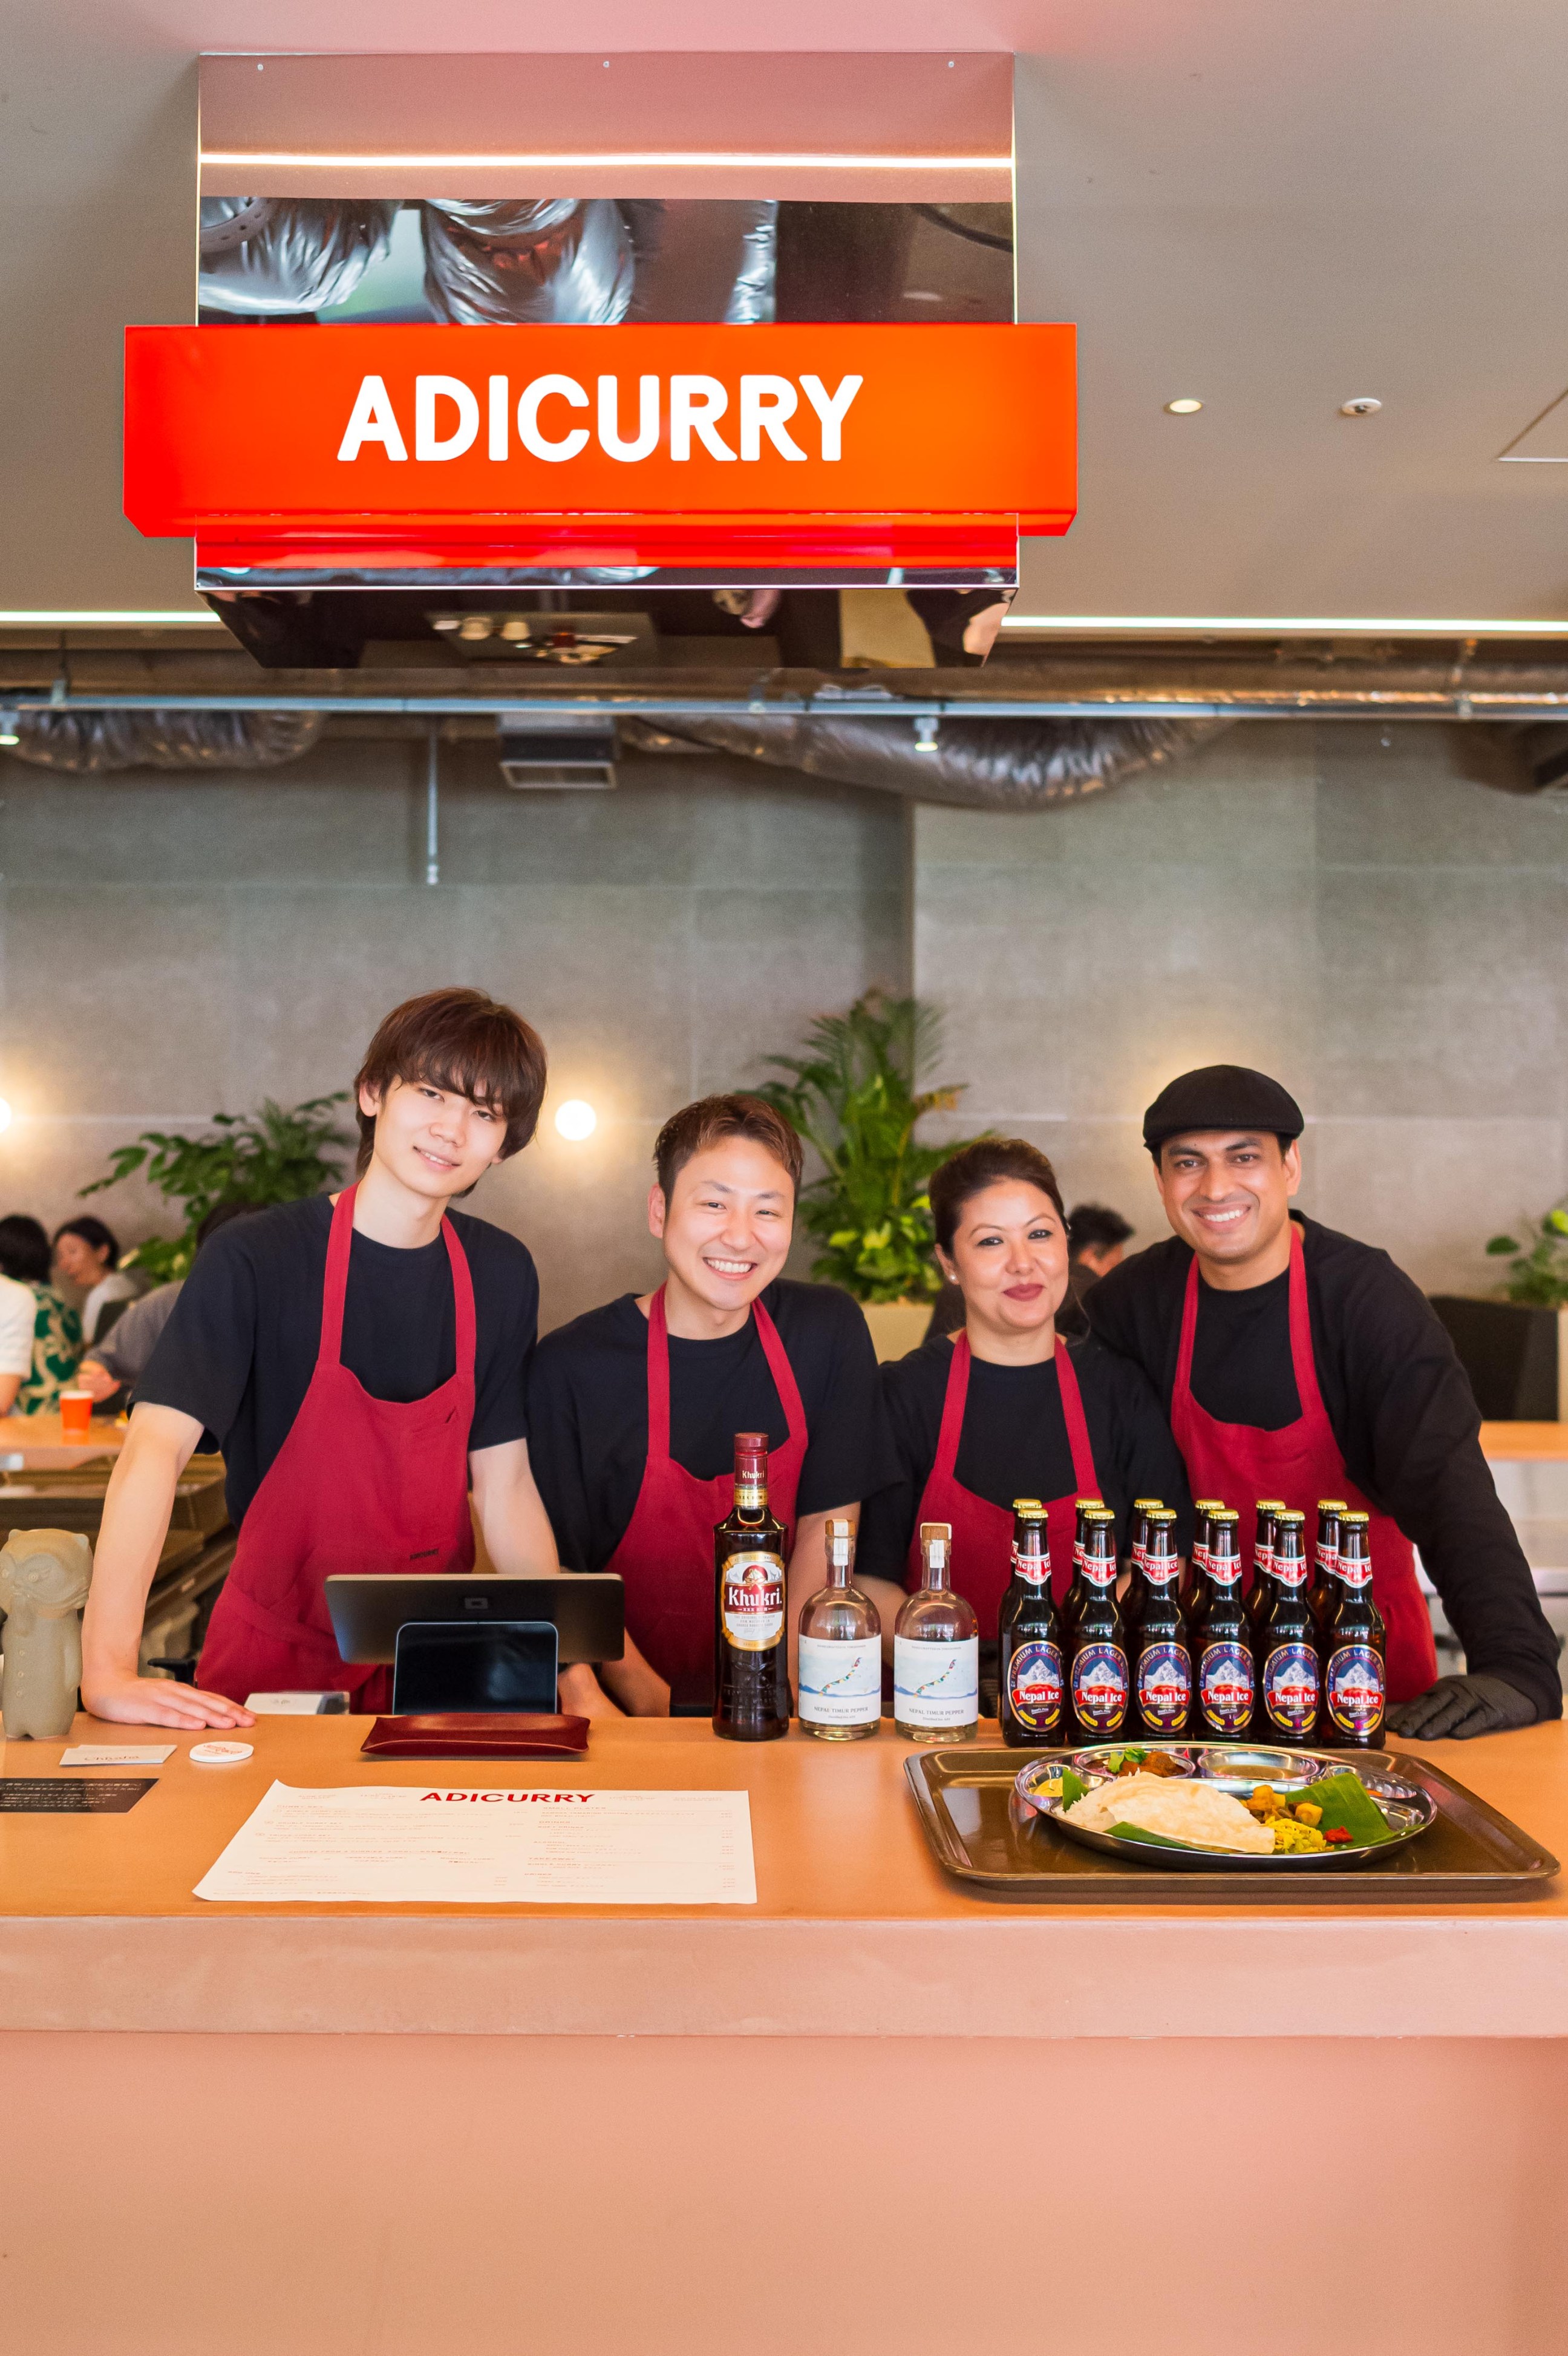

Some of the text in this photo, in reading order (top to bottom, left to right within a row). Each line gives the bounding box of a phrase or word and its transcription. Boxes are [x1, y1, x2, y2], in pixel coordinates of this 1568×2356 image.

[337, 373, 864, 463] ADICURRY
[742, 1470, 765, 1479] Khukri
[1018, 1560, 1041, 1571] Nepal
[1083, 1560, 1107, 1572] Nepal
[1273, 1561, 1298, 1572] Nepal
[1338, 1562, 1362, 1573] Nepal
[728, 1586, 782, 1607] Khukri.
[1099, 1647, 1122, 1661] LAGER
[1011, 1645, 1058, 1680] PREMIUM LAGER
[1019, 1690, 1059, 1704] Nepal Ice
[1082, 1692, 1122, 1704] Nepal Ice
[1146, 1690, 1186, 1704] Nepal Ice
[1207, 1690, 1249, 1704] Nepal Ice
[1275, 1692, 1315, 1705] Nepal Ice
[1337, 1693, 1378, 1706] Nepal Ice
[419, 1792, 595, 1803] ADICURRY
